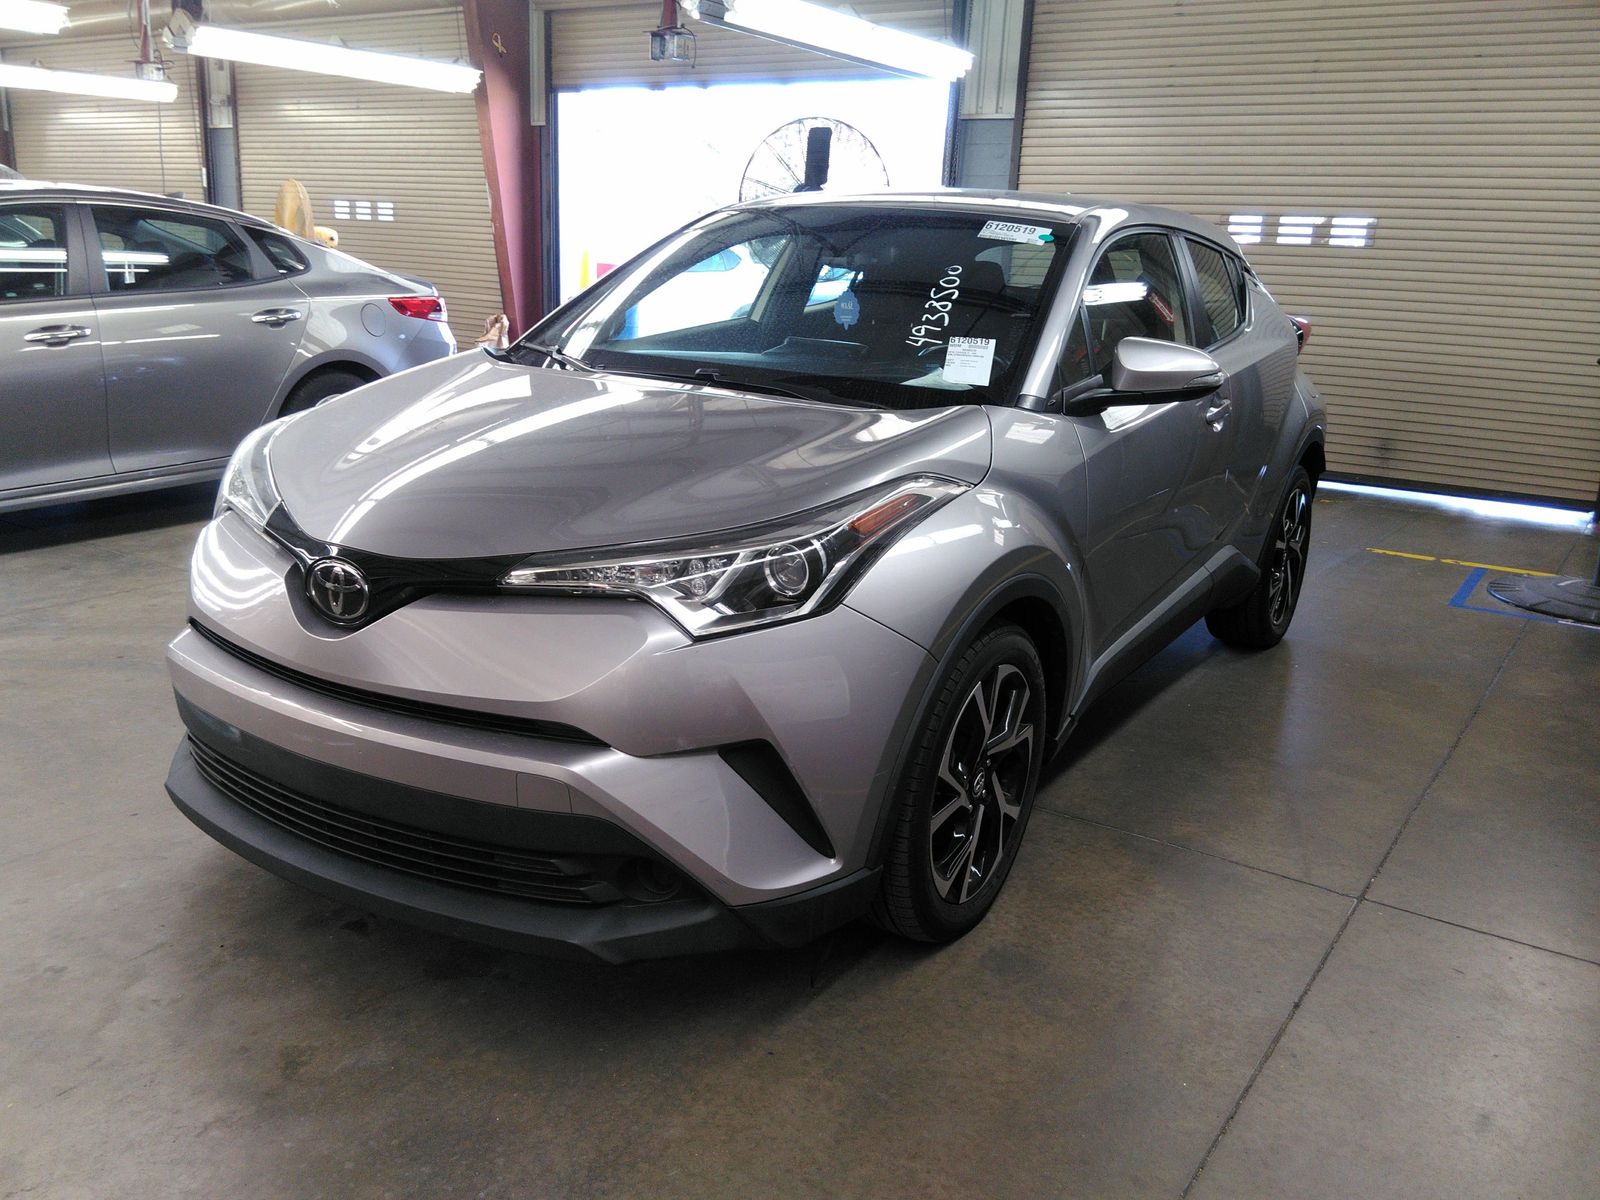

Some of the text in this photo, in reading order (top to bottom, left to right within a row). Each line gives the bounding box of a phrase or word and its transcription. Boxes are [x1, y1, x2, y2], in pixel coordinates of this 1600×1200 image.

[985, 222, 1036, 235] 6120519
[905, 265, 963, 347] 4938500
[950, 336, 990, 346] 6120519
